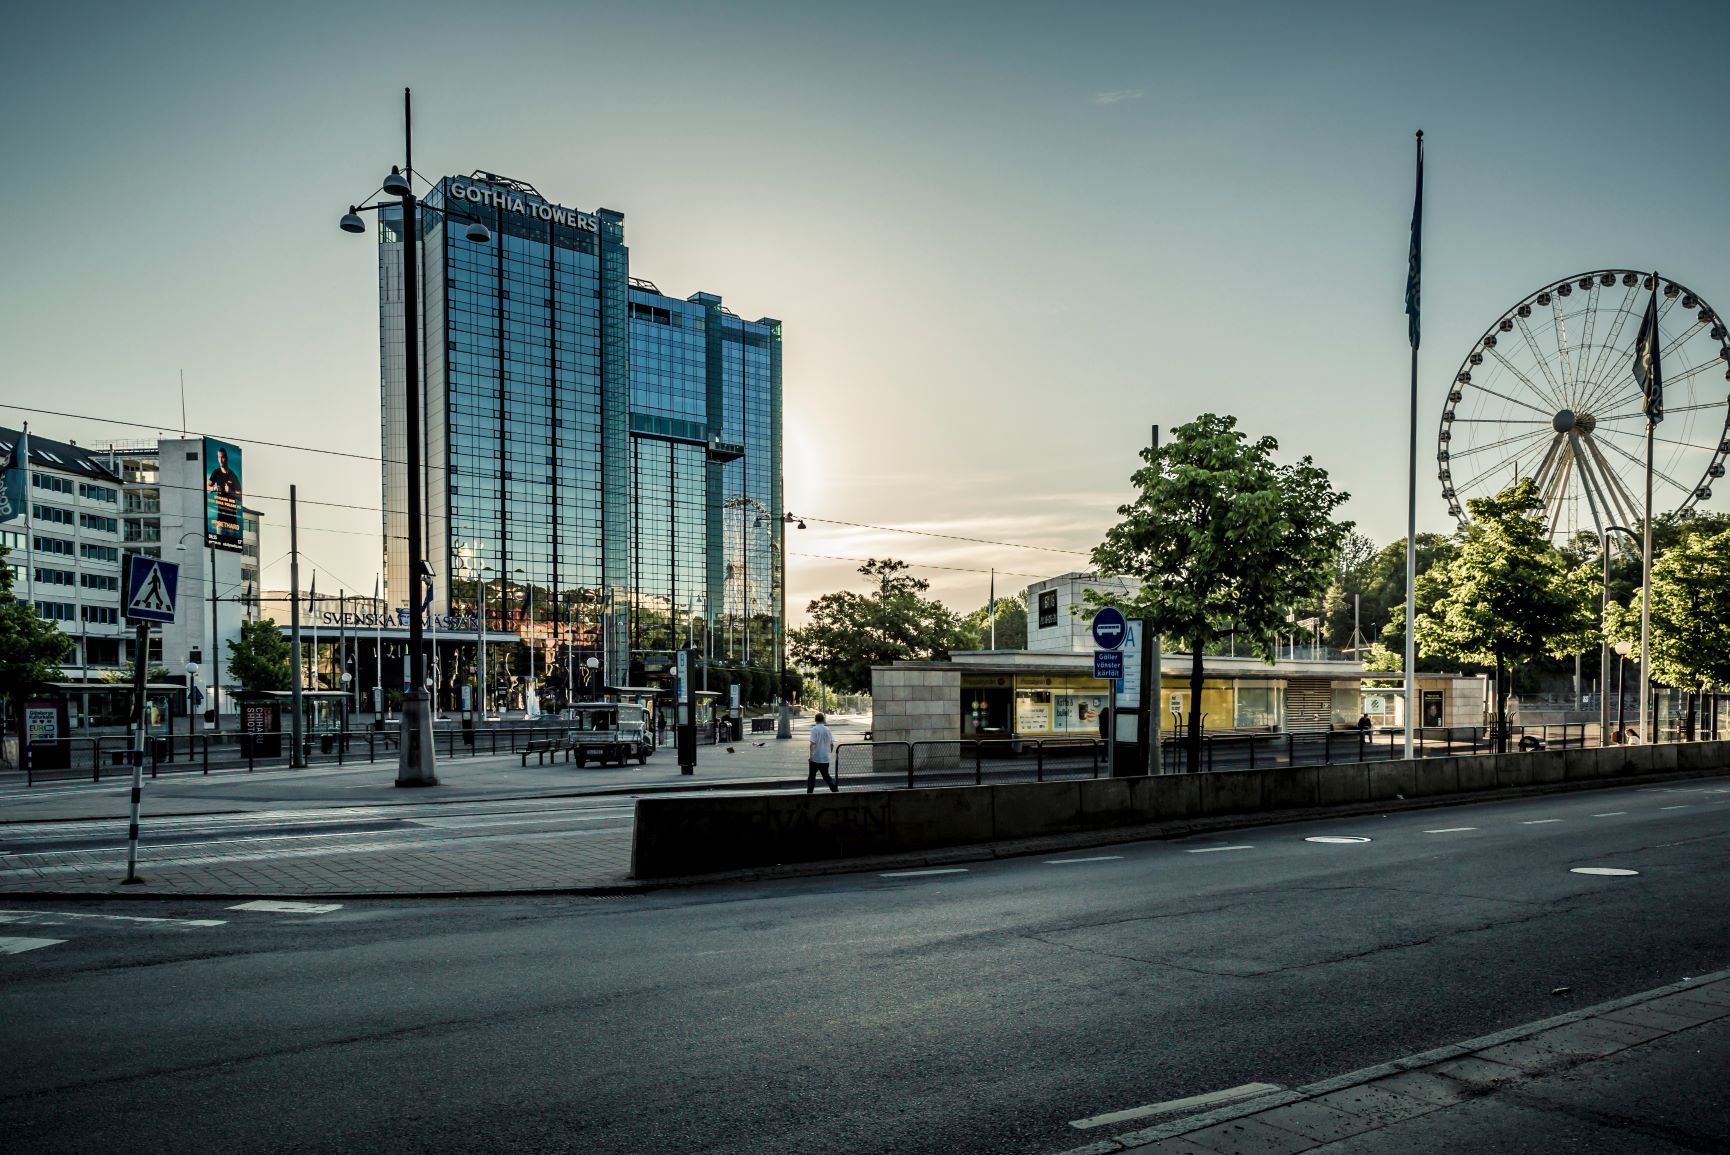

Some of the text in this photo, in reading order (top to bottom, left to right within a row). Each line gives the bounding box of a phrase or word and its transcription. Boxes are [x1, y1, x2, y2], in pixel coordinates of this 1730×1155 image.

[451, 182, 598, 232] GOTHIA TOWERS
[323, 611, 478, 628] SVENSKA MÄSSAN
[1124, 625, 1135, 648] A
[1096, 661, 1121, 669] vänster
[1097, 669, 1120, 677] körfält
